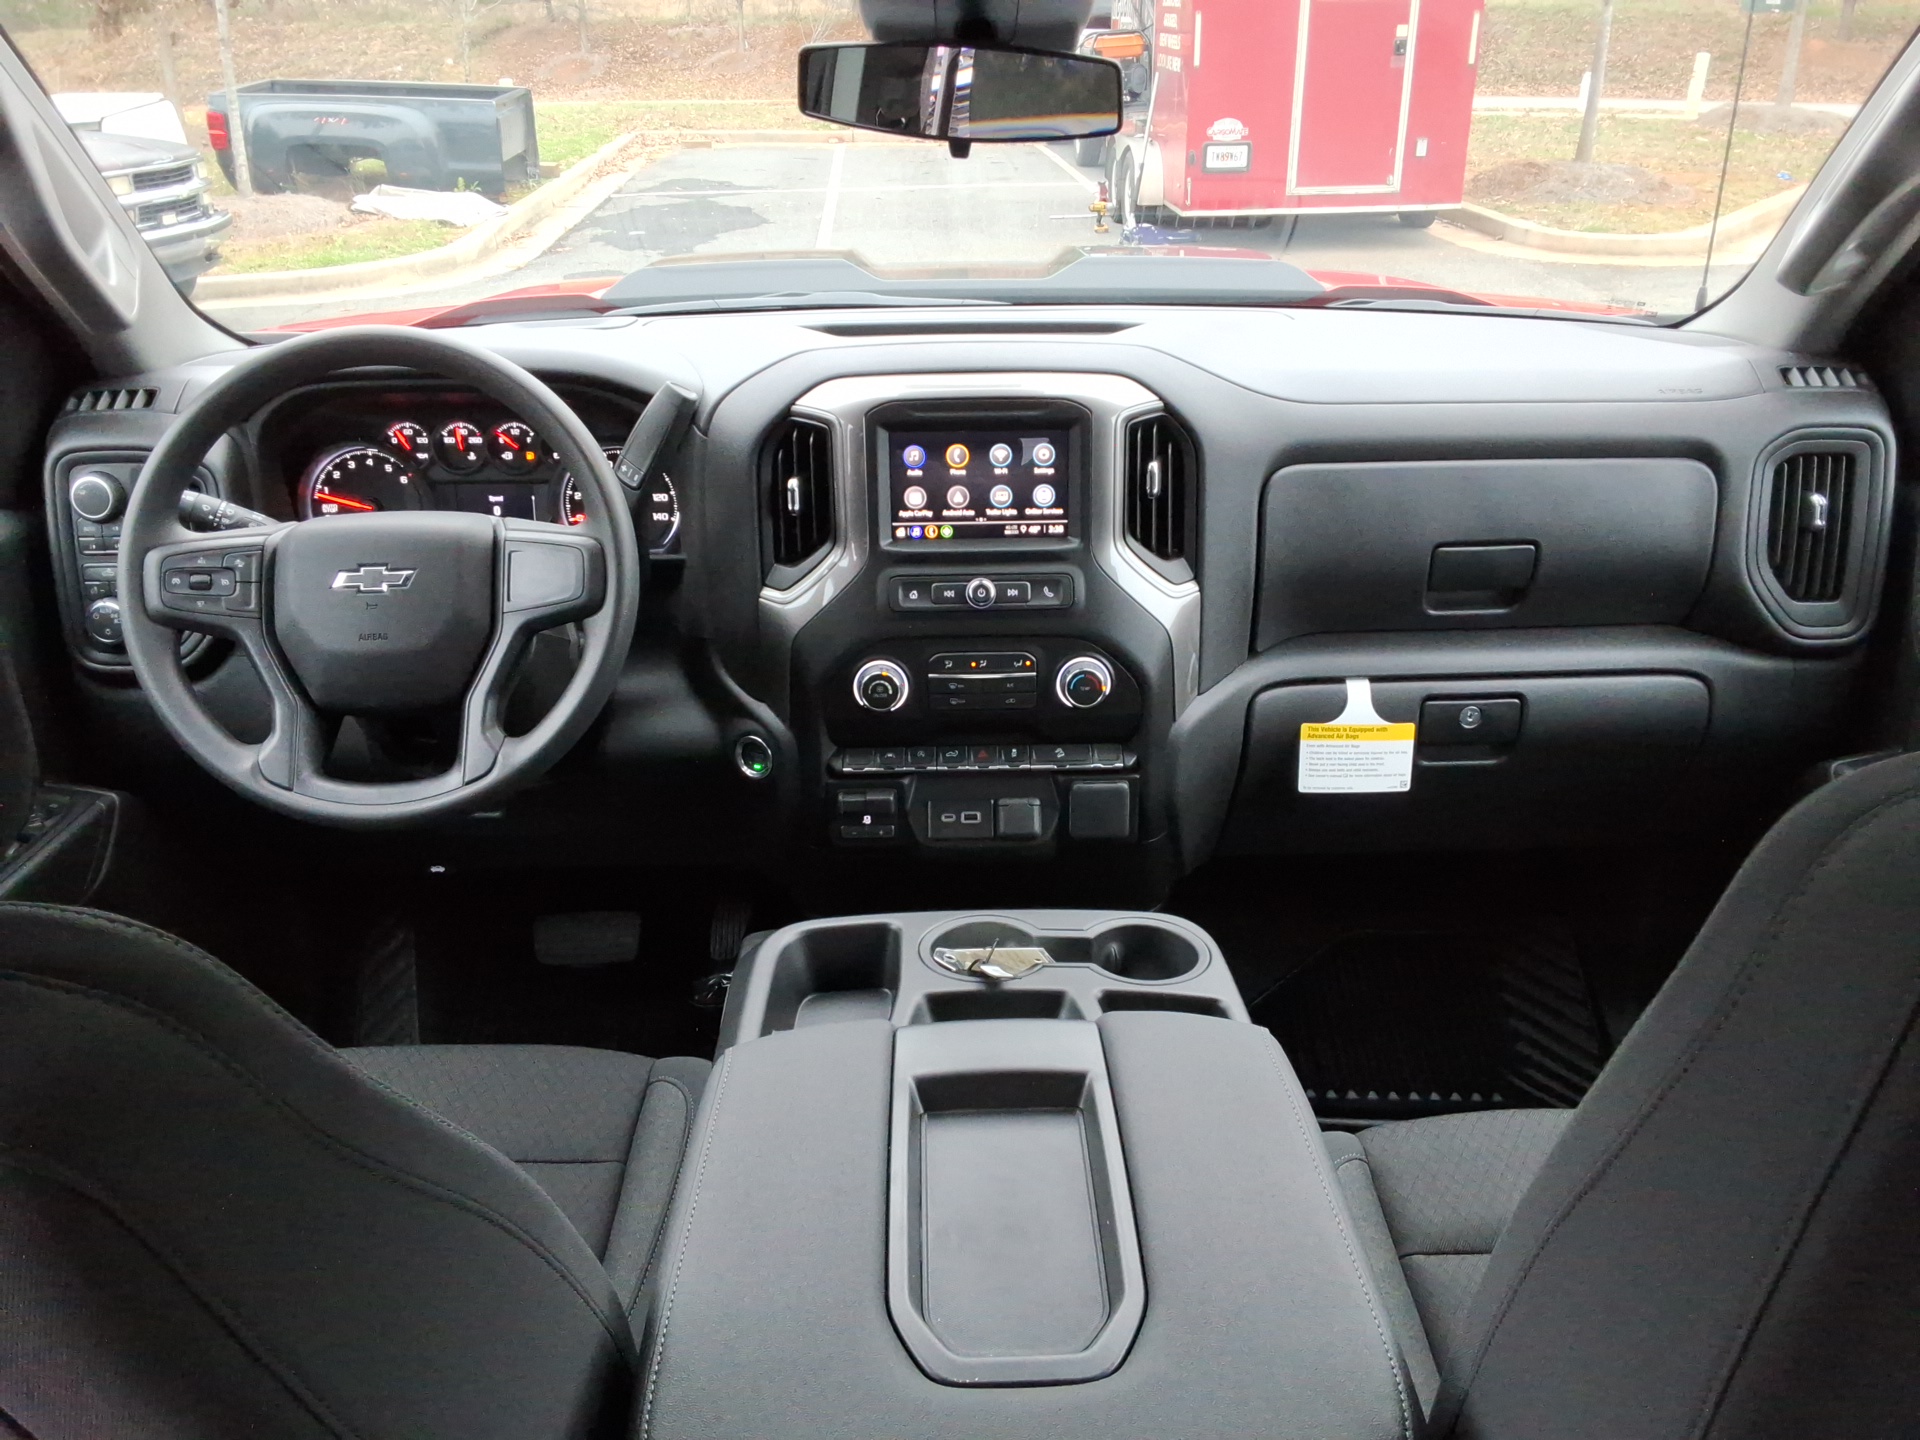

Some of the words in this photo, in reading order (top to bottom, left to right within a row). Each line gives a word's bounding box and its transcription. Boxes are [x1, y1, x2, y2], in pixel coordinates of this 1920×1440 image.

[347, 461, 355, 469] 3
[366, 458, 373, 466] 4
[384, 464, 392, 472] 5
[333, 471, 340, 479] 2
[400, 476, 408, 484] 6
[652, 493, 668, 501] 120
[493, 505, 501, 516] 0
[652, 513, 668, 521] 140
[1349, 726, 1375, 734] Equipped
